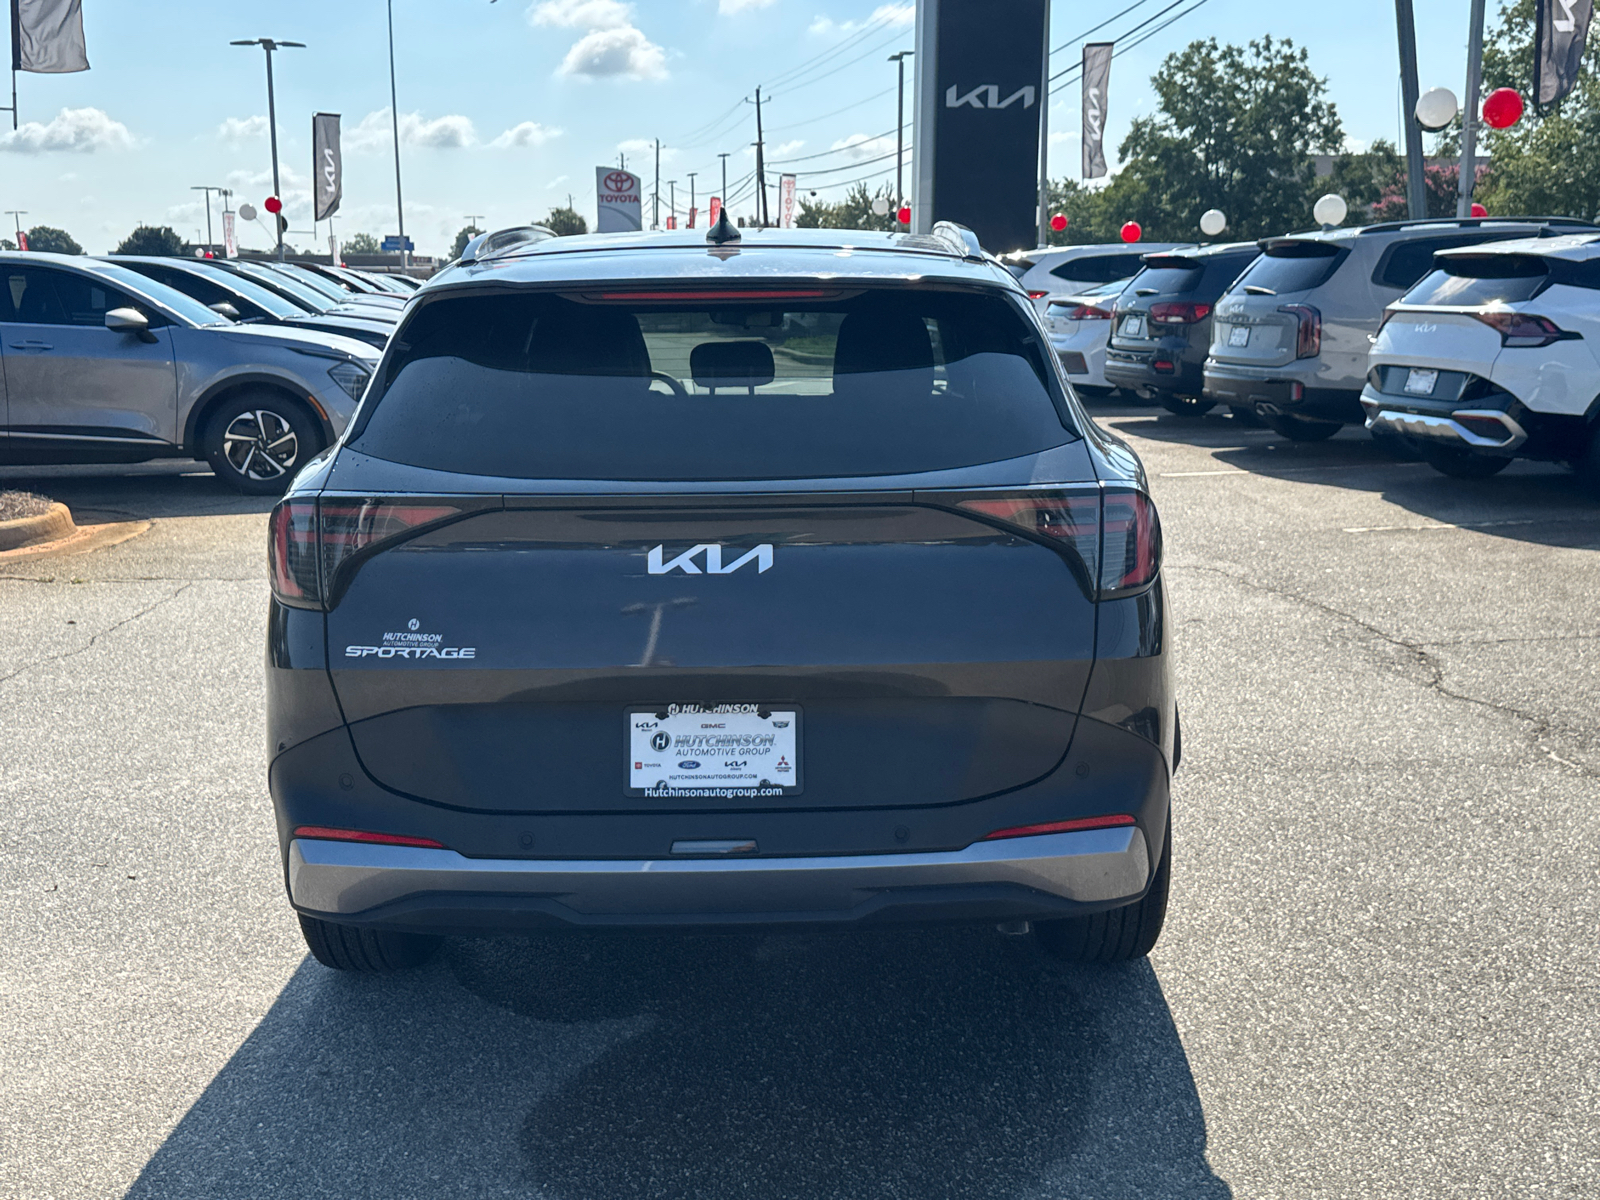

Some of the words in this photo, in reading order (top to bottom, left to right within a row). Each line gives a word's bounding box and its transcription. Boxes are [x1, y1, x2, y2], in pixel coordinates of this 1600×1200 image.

[945, 83, 1036, 110] KIA
[1087, 87, 1102, 141] KIA
[323, 147, 336, 193] KIA
[599, 194, 640, 203] TOYOTA
[784, 189, 793, 229] TOYOT
[1414, 323, 1437, 333] KIA
[647, 543, 774, 575] KIA
[383, 632, 443, 643] HUTCHINSON
[345, 645, 477, 659] SPORTAGE
[682, 703, 759, 715] HUHINSON
[635, 722, 658, 730] KIA
[674, 734, 776, 748] HUTCHINSON
[675, 748, 736, 757] AUTOMOTIVE
[738, 748, 771, 756] GROUP
[644, 787, 783, 799] Hutchinsonautogroup.com
